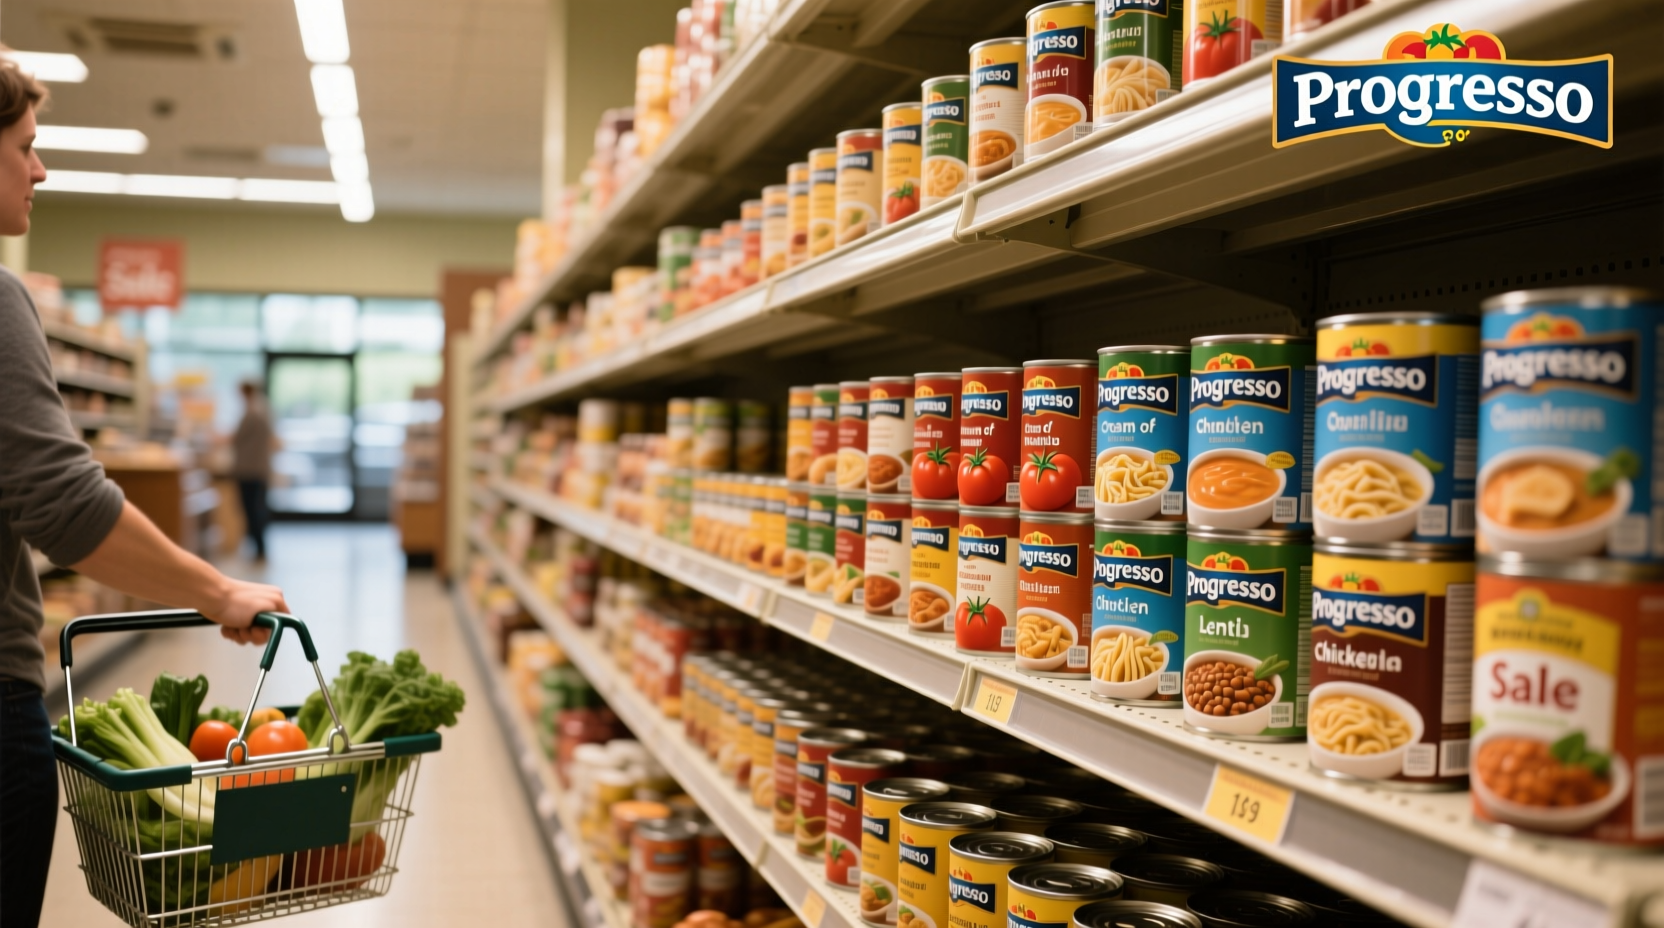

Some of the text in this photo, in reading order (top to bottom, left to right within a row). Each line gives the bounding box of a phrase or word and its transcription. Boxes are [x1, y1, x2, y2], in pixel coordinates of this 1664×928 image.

[1190, 376, 1282, 403] Progresso
[1317, 364, 1427, 395] Progresso
[1140, 417, 1157, 434] of
[1187, 571, 1276, 602] Progresso
[1312, 591, 1416, 630] Progresso
[1491, 660, 1580, 712] Sale
